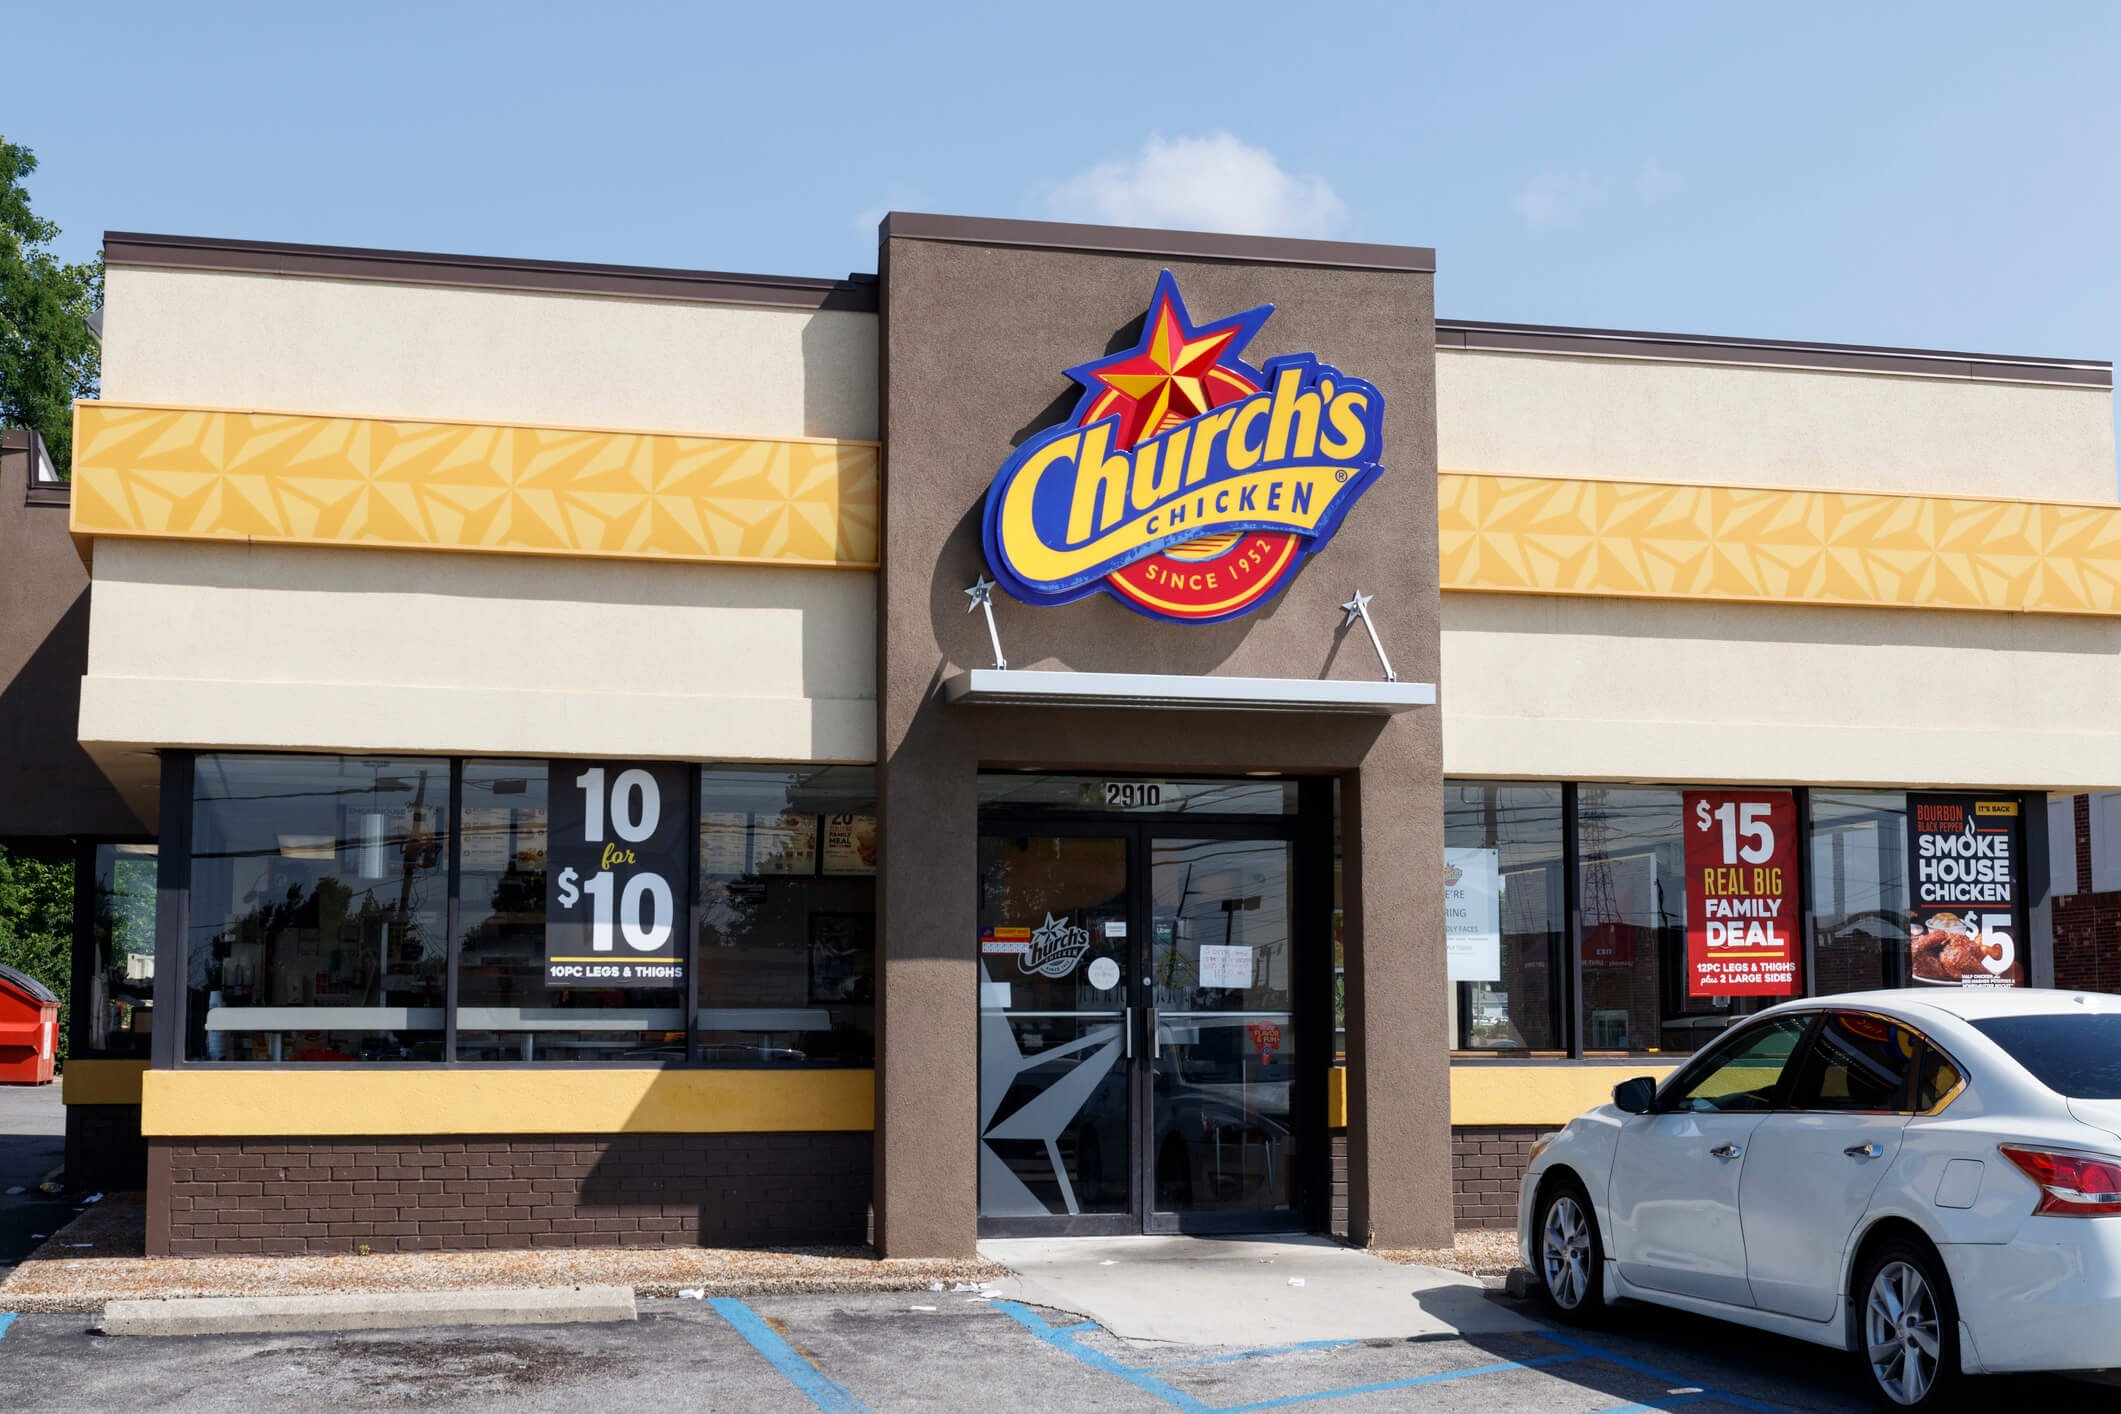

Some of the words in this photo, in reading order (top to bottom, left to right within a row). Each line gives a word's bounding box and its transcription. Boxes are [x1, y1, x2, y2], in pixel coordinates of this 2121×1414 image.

[1002, 368, 1368, 581] Church's
[1146, 481, 1314, 535] CHICKEN
[1145, 565, 1218, 590] SINCE
[1230, 539, 1271, 579] 1952
[577, 767, 661, 843] 10
[1107, 783, 1160, 807] 2910
[1917, 804, 1964, 821] BOURBON
[1978, 804, 1991, 812] IT'S
[1992, 804, 2010, 813] BACK
[1696, 799, 1775, 865] $15
[1917, 821, 1938, 833] BLACK
[1939, 821, 1964, 833] PEPPER
[601, 842, 636, 870] for
[1918, 833, 2009, 857] SMOKE
[1704, 868, 1750, 895] REAL
[1754, 867, 1783, 895] BIG
[1919, 858, 2010, 882] HOUSE
[1445, 889, 1465, 899] E'RE
[1920, 883, 2011, 901] CHICKEN
[557, 866, 674, 952] $10
[1705, 898, 1783, 917] FAMILY
[1706, 921, 1784, 947] DEAL
[1964, 910, 2016, 975] $5
[550, 966, 583, 977] 10PC
[586, 966, 620, 977] LEGS
[623, 966, 631, 977] &
[634, 966, 683, 978] THIGHS
[1697, 963, 1721, 972] 12PC
[1722, 963, 1749, 972] LEGS
[1751, 963, 1758, 972] &
[1760, 962, 1796, 972] THIGHS
[1700, 973, 1719, 986] plus
[1720, 974, 1727, 983] 2
[1729, 974, 1762, 983] LARGE
[1764, 973, 1793, 983] SIDES
